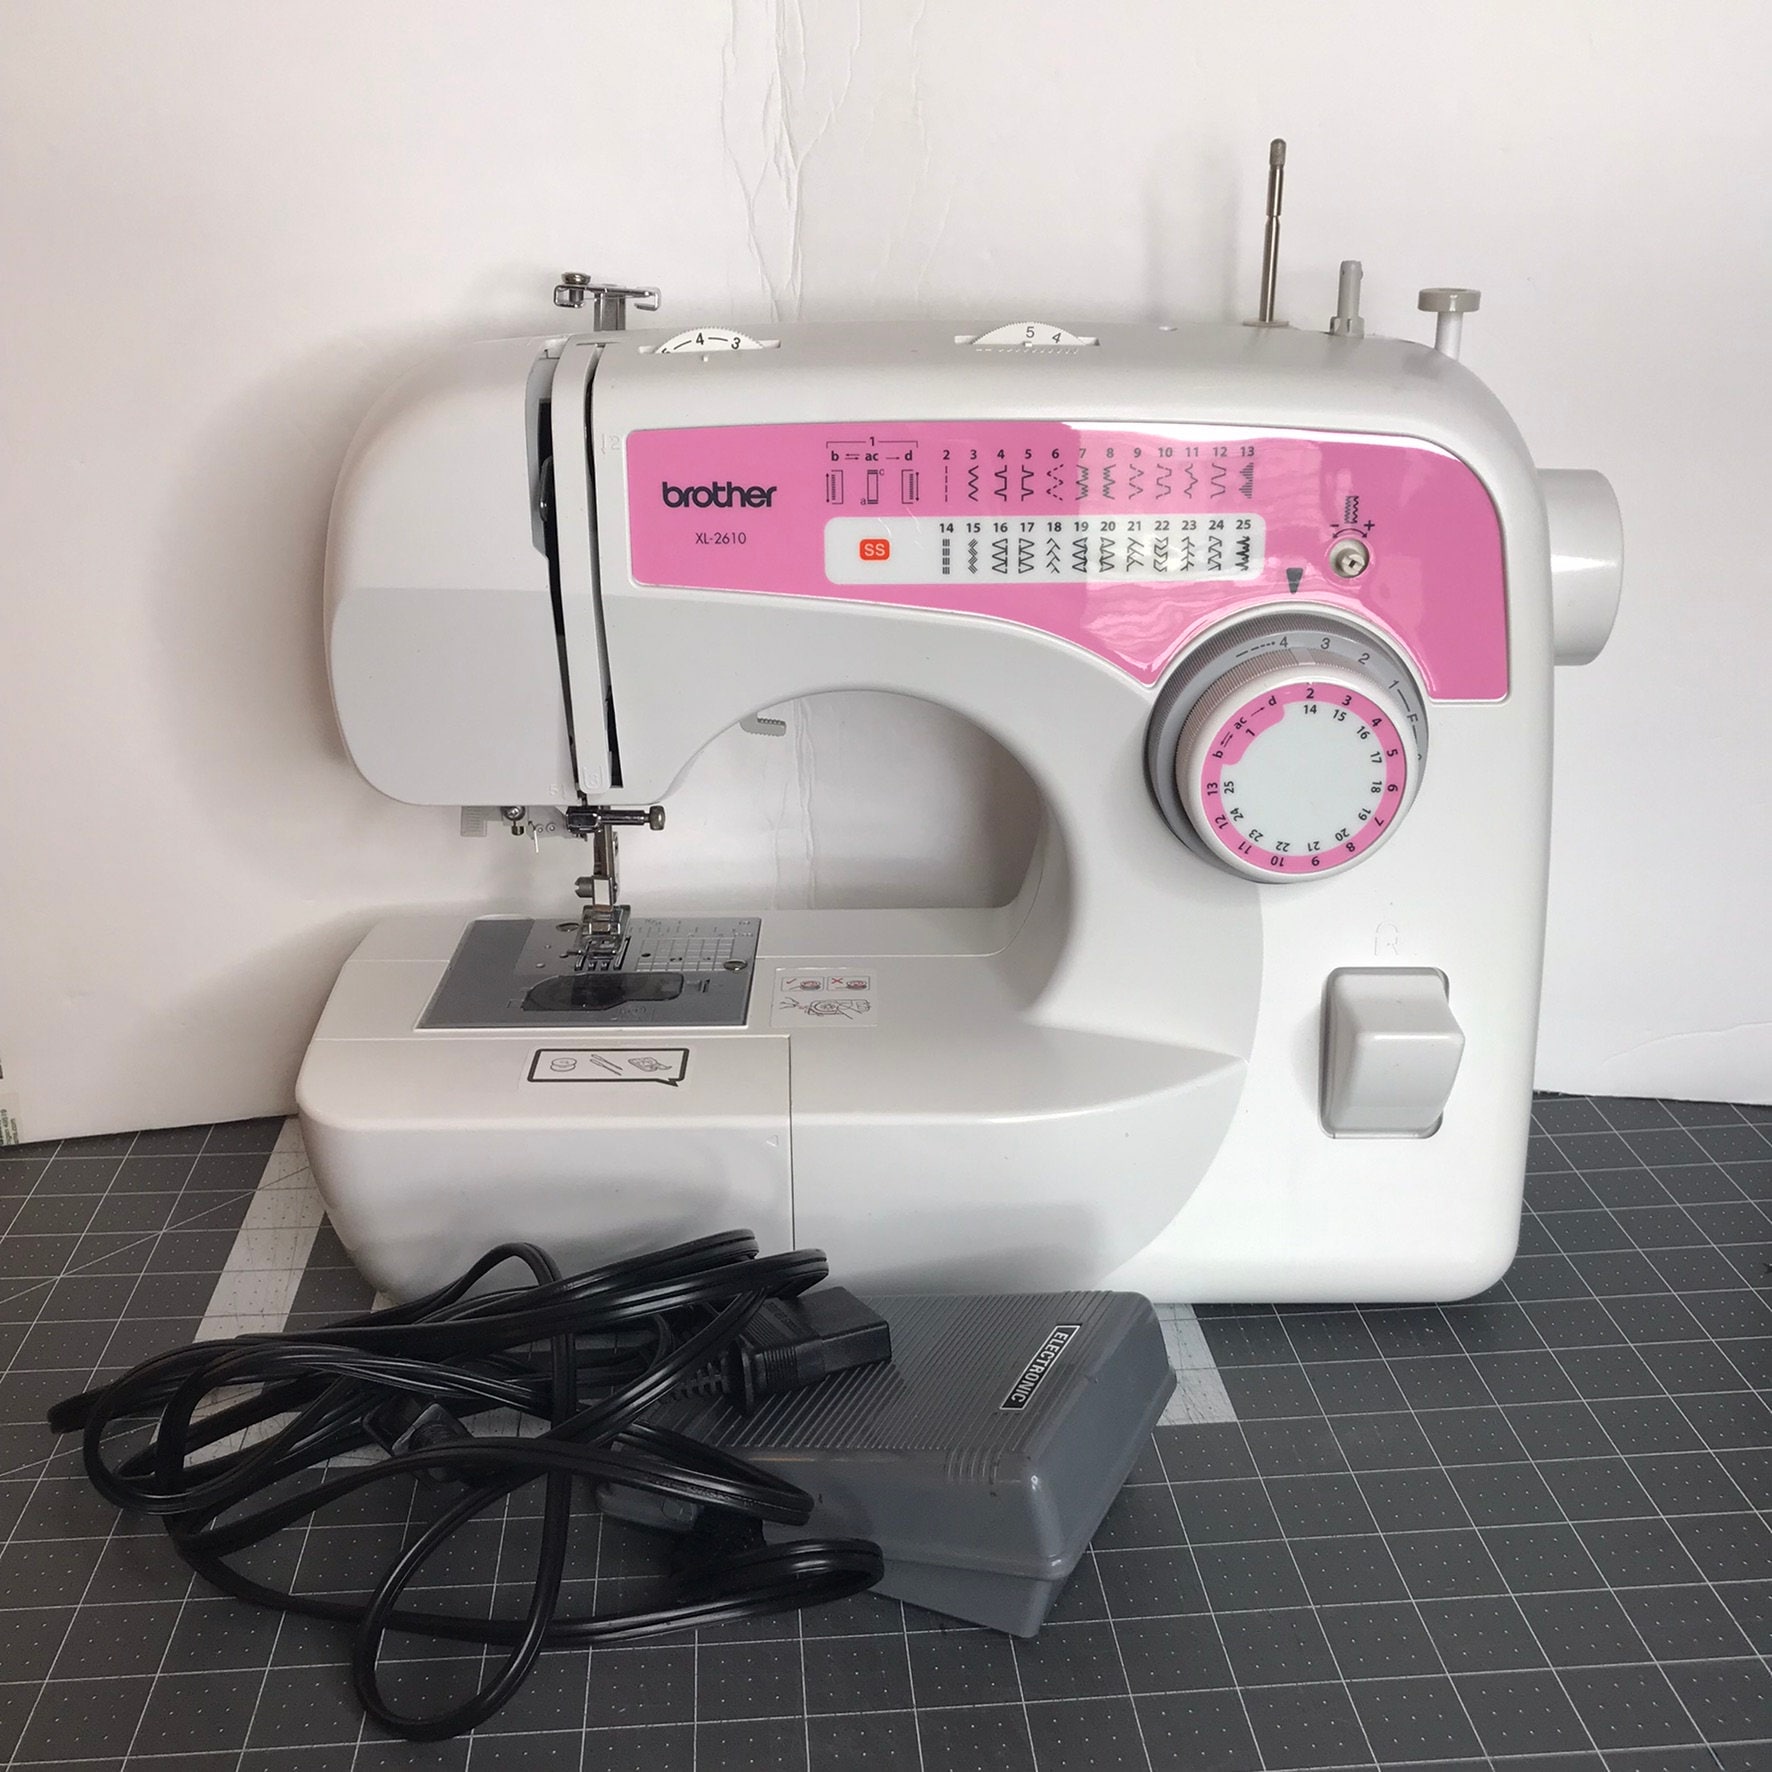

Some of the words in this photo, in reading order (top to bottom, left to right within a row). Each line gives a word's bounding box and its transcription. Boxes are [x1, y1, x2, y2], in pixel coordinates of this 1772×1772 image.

[1026, 326, 1035, 338] 5
[1052, 332, 1061, 343] 4
[696, 332, 704, 345] 4
[731, 337, 741, 350] 3
[869, 436, 875, 446] 1
[831, 450, 839, 461] b
[865, 453, 879, 461] ac
[904, 450, 913, 461] d
[943, 450, 950, 460] 2
[970, 449, 977, 460] 3
[997, 449, 1005, 459] 4
[1024, 449, 1032, 459] 5
[1051, 448, 1059, 459] 6
[1079, 448, 1087, 458] 7
[1106, 447, 1114, 458] 8
[1133, 447, 1142, 458] 9
[1158, 447, 1173, 458] 10
[1185, 447, 1199, 457] 11
[1212, 446, 1228, 457] 12
[1240, 446, 1255, 457] 13
[879, 468, 885, 476] c
[662, 481, 777, 508] brother
[939, 523, 954, 533] 14
[966, 523, 981, 533] 15
[993, 522, 1008, 533] 16
[1020, 522, 1035, 533] 17
[1047, 522, 1062, 532] 18
[1074, 521, 1089, 532] 19
[1100, 521, 1116, 532] 20
[1127, 521, 1141, 531] 21
[1154, 520, 1170, 531] 22
[1181, 520, 1197, 531] 23
[1208, 520, 1224, 531] 24
[1235, 519, 1252, 530] 25
[695, 532, 747, 544] XL-2610
[864, 543, 886, 557] SS
[1280, 636, 1288, 648] 4
[1320, 637, 1331, 650] 3
[1358, 652, 1370, 665] 2
[1388, 680, 1400, 690] 1
[1406, 713, 1418, 723] F
[1306, 688, 1315, 699] 2
[1341, 695, 1352, 706] 3
[1304, 704, 1317, 714] 14
[1333, 709, 1347, 722] 15
[1212, 750, 1224, 759] b
[1233, 716, 1247, 730] ac
[1268, 695, 1277, 706] d
[1371, 718, 1382, 727] 4
[1245, 728, 1256, 737] 1
[1357, 726, 1371, 740] 16
[1370, 751, 1382, 763] 17
[1386, 749, 1398, 757] 5
[1206, 782, 1218, 796] 13
[1224, 781, 1235, 794] 25
[1371, 781, 1383, 793] 18
[1387, 784, 1398, 792] 6
[1230, 807, 1244, 822] 24
[1358, 808, 1372, 821] 19
[1215, 814, 1229, 830] 12
[1374, 817, 1385, 826] 7
[1248, 829, 1264, 842] 23
[1335, 828, 1350, 841] 20
[1238, 841, 1252, 855] 11
[1275, 841, 1290, 852] 22
[1307, 841, 1321, 852] 21
[1345, 842, 1356, 852] 8
[1270, 856, 1284, 867] 10
[1311, 856, 1320, 867] 9
[1011, 1331, 1069, 1403] ELECTRONIC
